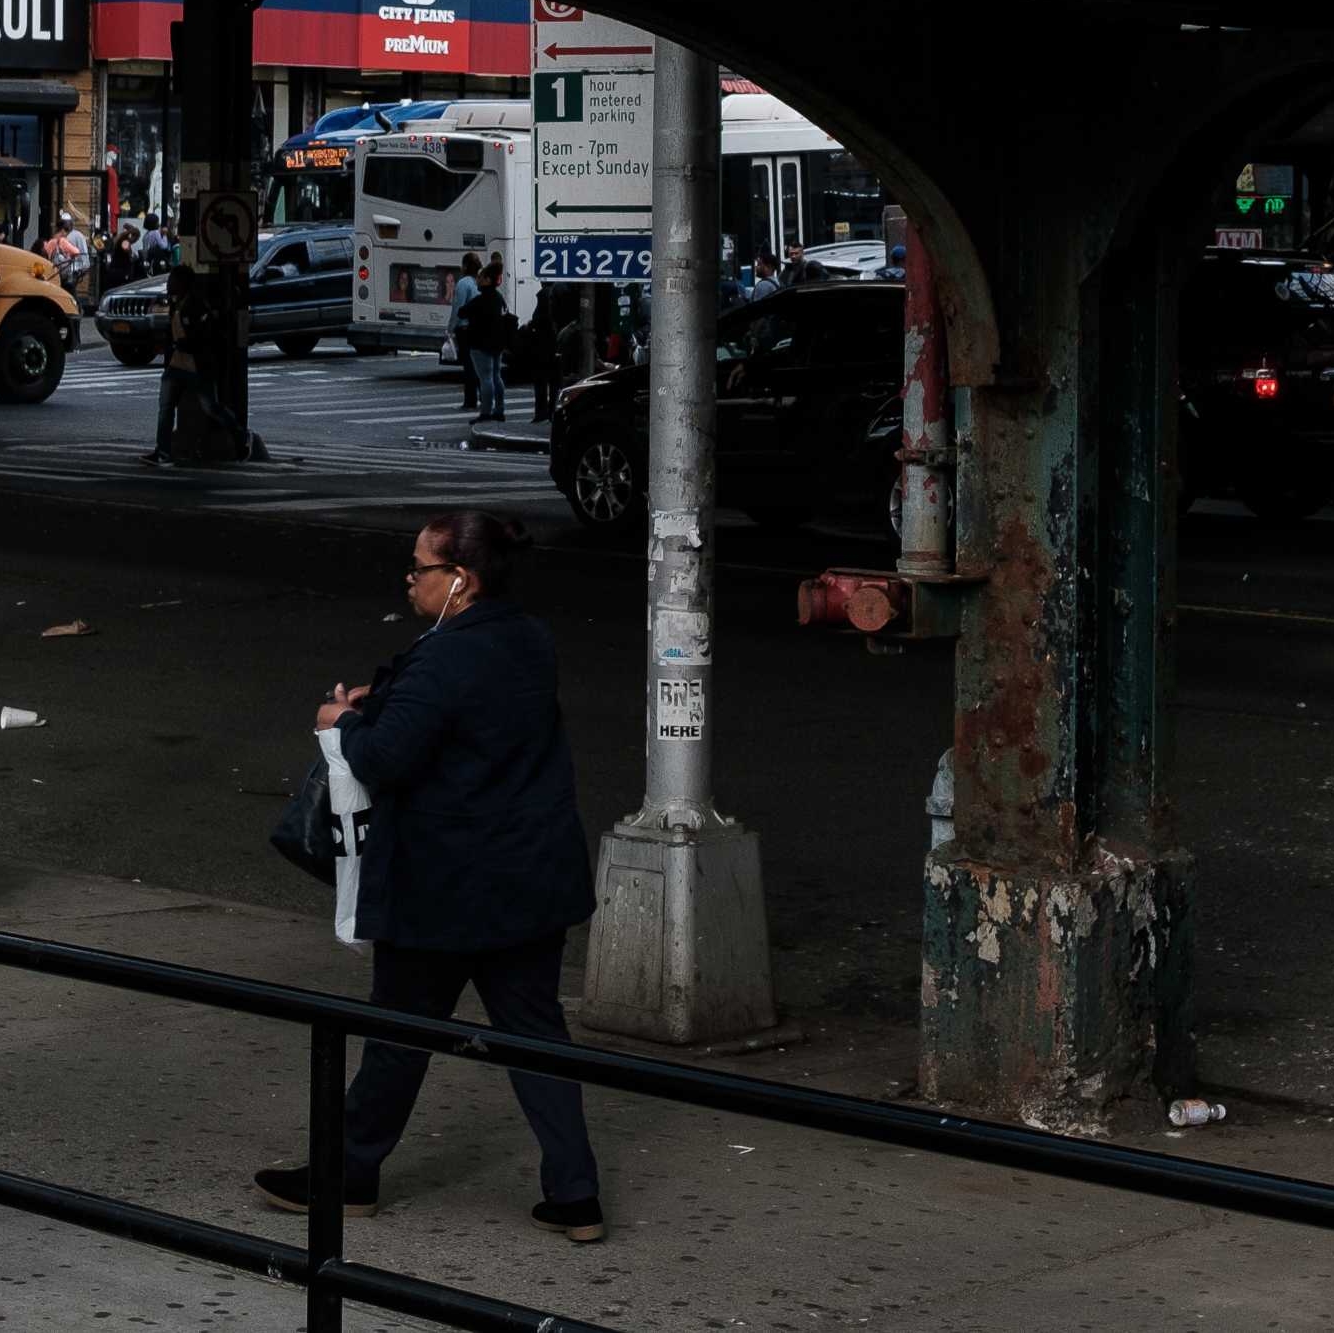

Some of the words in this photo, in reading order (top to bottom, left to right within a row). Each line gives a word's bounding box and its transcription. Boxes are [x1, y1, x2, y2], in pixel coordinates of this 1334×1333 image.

[378, 5, 413, 21] CITY
[413, 8, 455, 24] JEANS
[589, 79, 617, 92] hour
[550, 77, 565, 118] 1
[589, 93, 642, 107] metered
[589, 109, 635, 125] parking
[542, 141, 572, 155] 8am
[589, 140, 618, 158] 7pm
[542, 160, 591, 178] Except
[596, 158, 649, 177] Sunday
[1218, 231, 1256, 247] ATM
[539, 249, 653, 275] 213279
[659, 724, 700, 738] HERE
